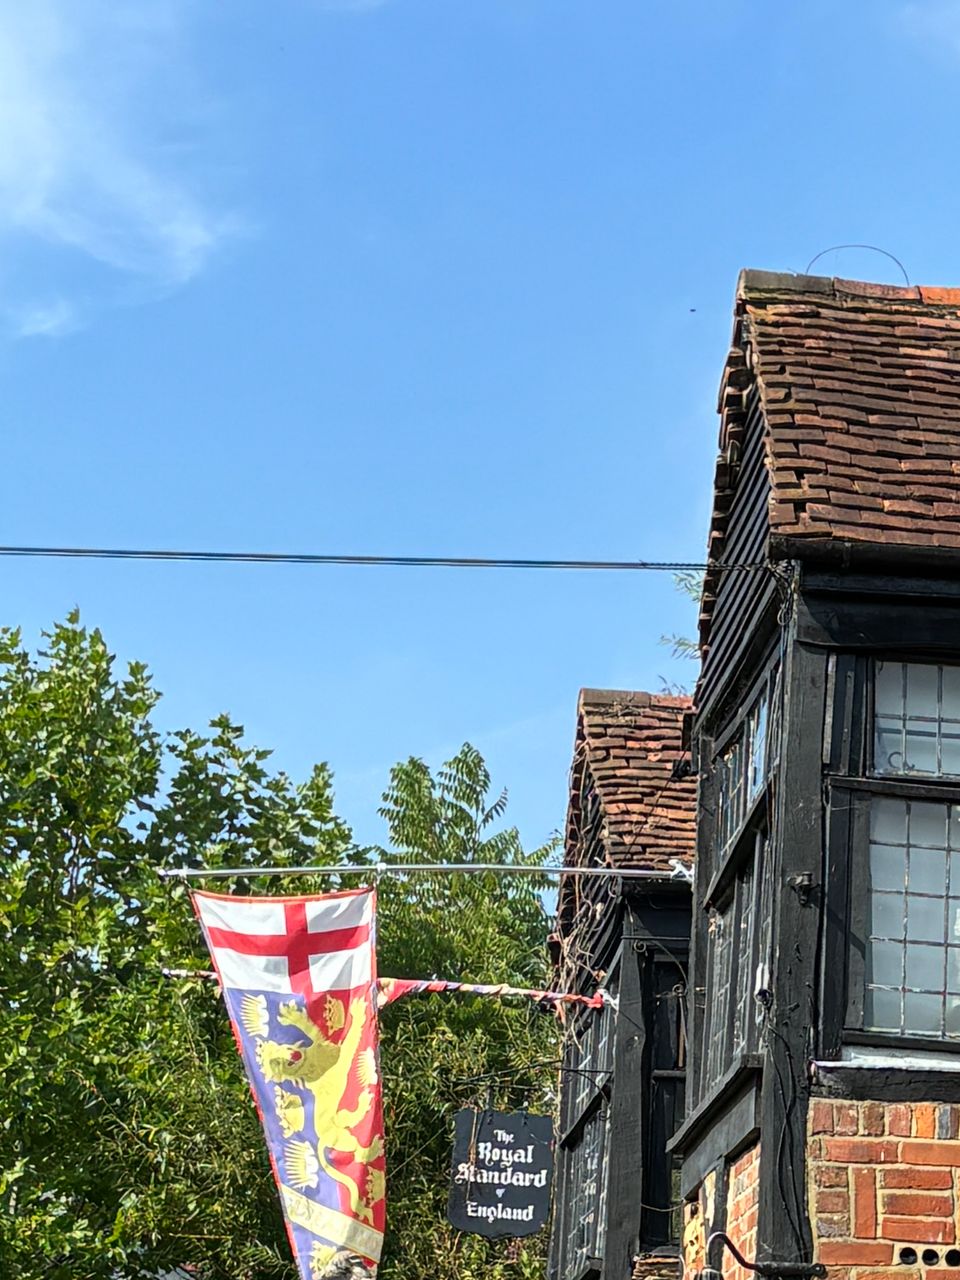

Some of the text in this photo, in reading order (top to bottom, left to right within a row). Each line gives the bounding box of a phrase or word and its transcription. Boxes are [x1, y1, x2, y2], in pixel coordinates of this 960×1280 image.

[493, 1129, 515, 1145] The
[478, 1142, 535, 1168] Royal
[455, 1162, 548, 1188] Standard
[466, 1200, 535, 1223] England
